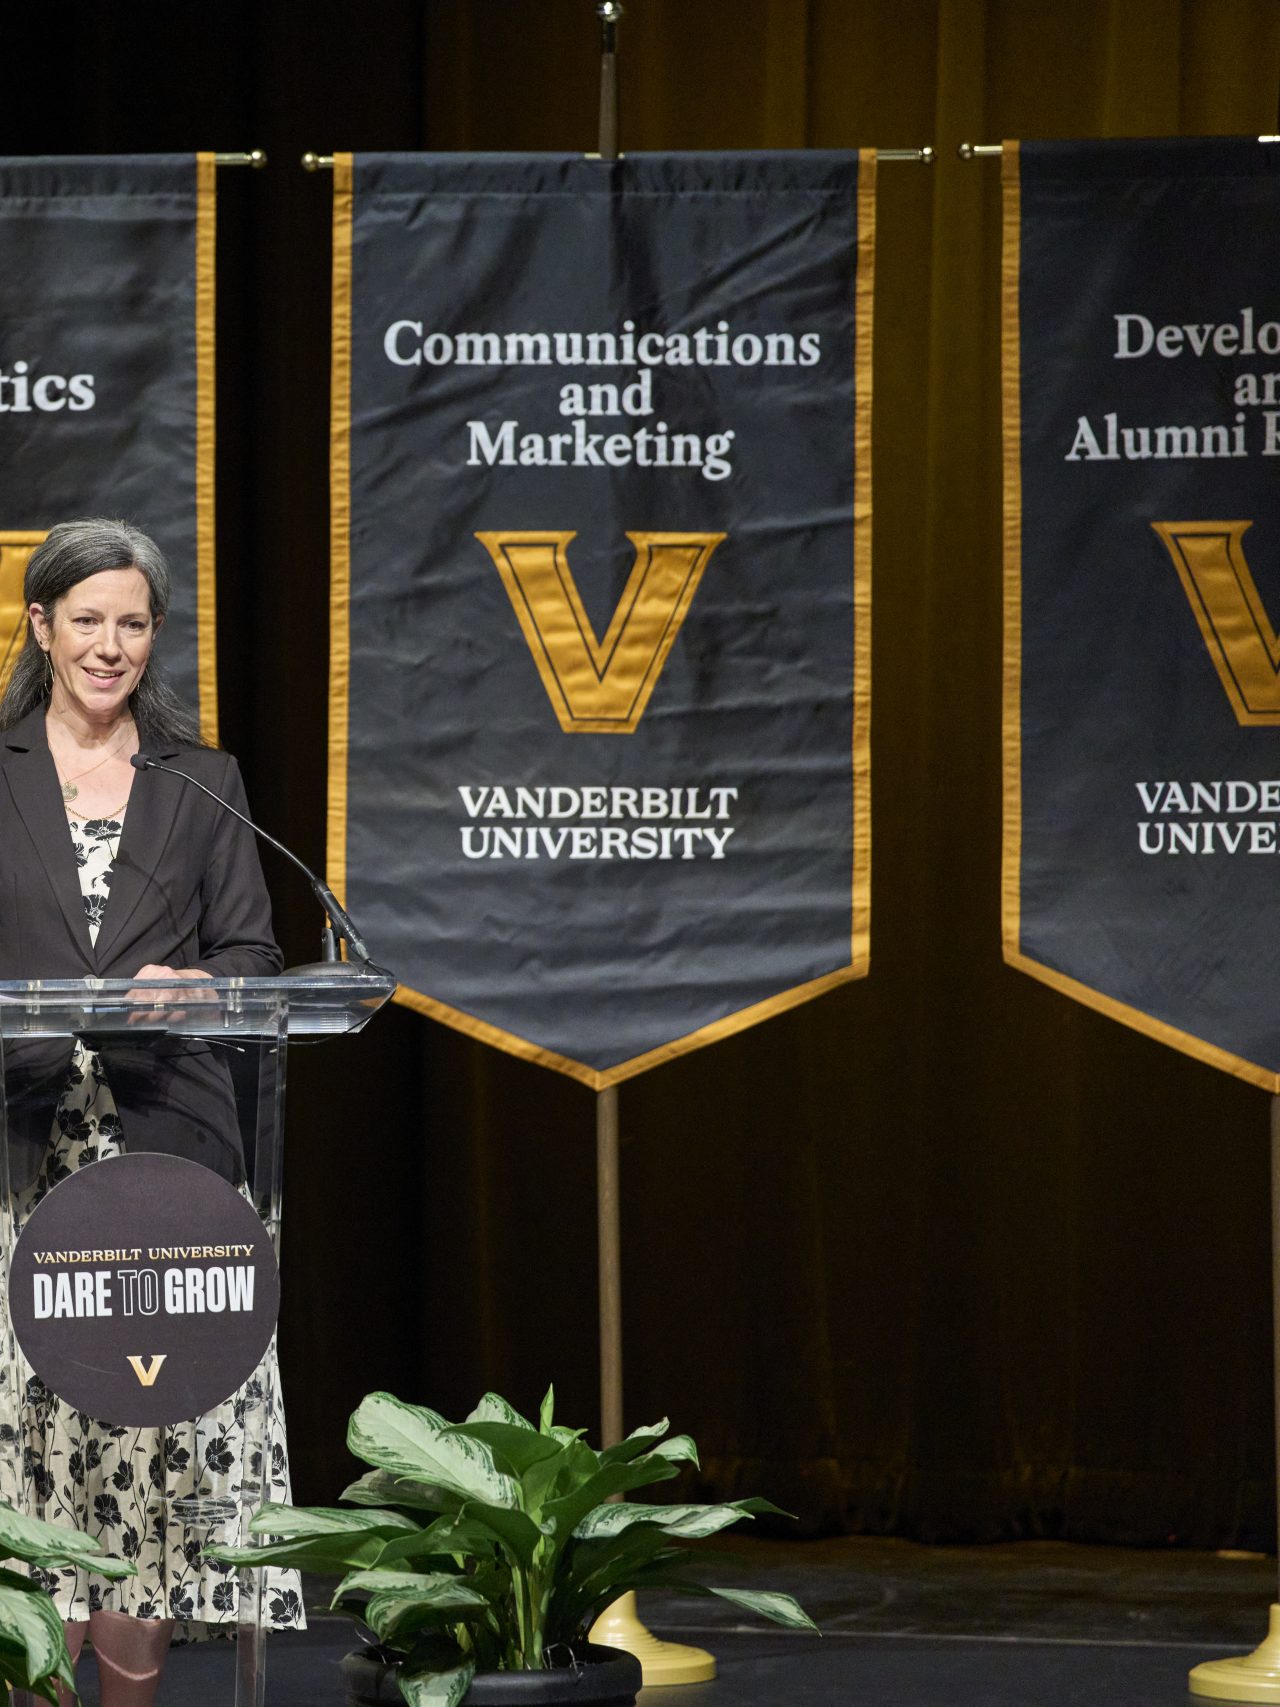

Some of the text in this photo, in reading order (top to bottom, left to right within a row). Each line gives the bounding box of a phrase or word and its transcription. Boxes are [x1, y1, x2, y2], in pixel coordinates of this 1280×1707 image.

[382, 319, 821, 367] Communications
[558, 369, 654, 416] and
[466, 418, 735, 481] Marketing
[1064, 412, 1248, 461] Alumni
[474, 530, 728, 734] V
[457, 785, 738, 819] VANDERBILT
[460, 826, 735, 859] UNIVERSITY
[33, 1244, 255, 1264] VANDERBILT UNIVERSITY
[33, 1265, 255, 1319] DARE TO GROW
[126, 1354, 168, 1387] V
